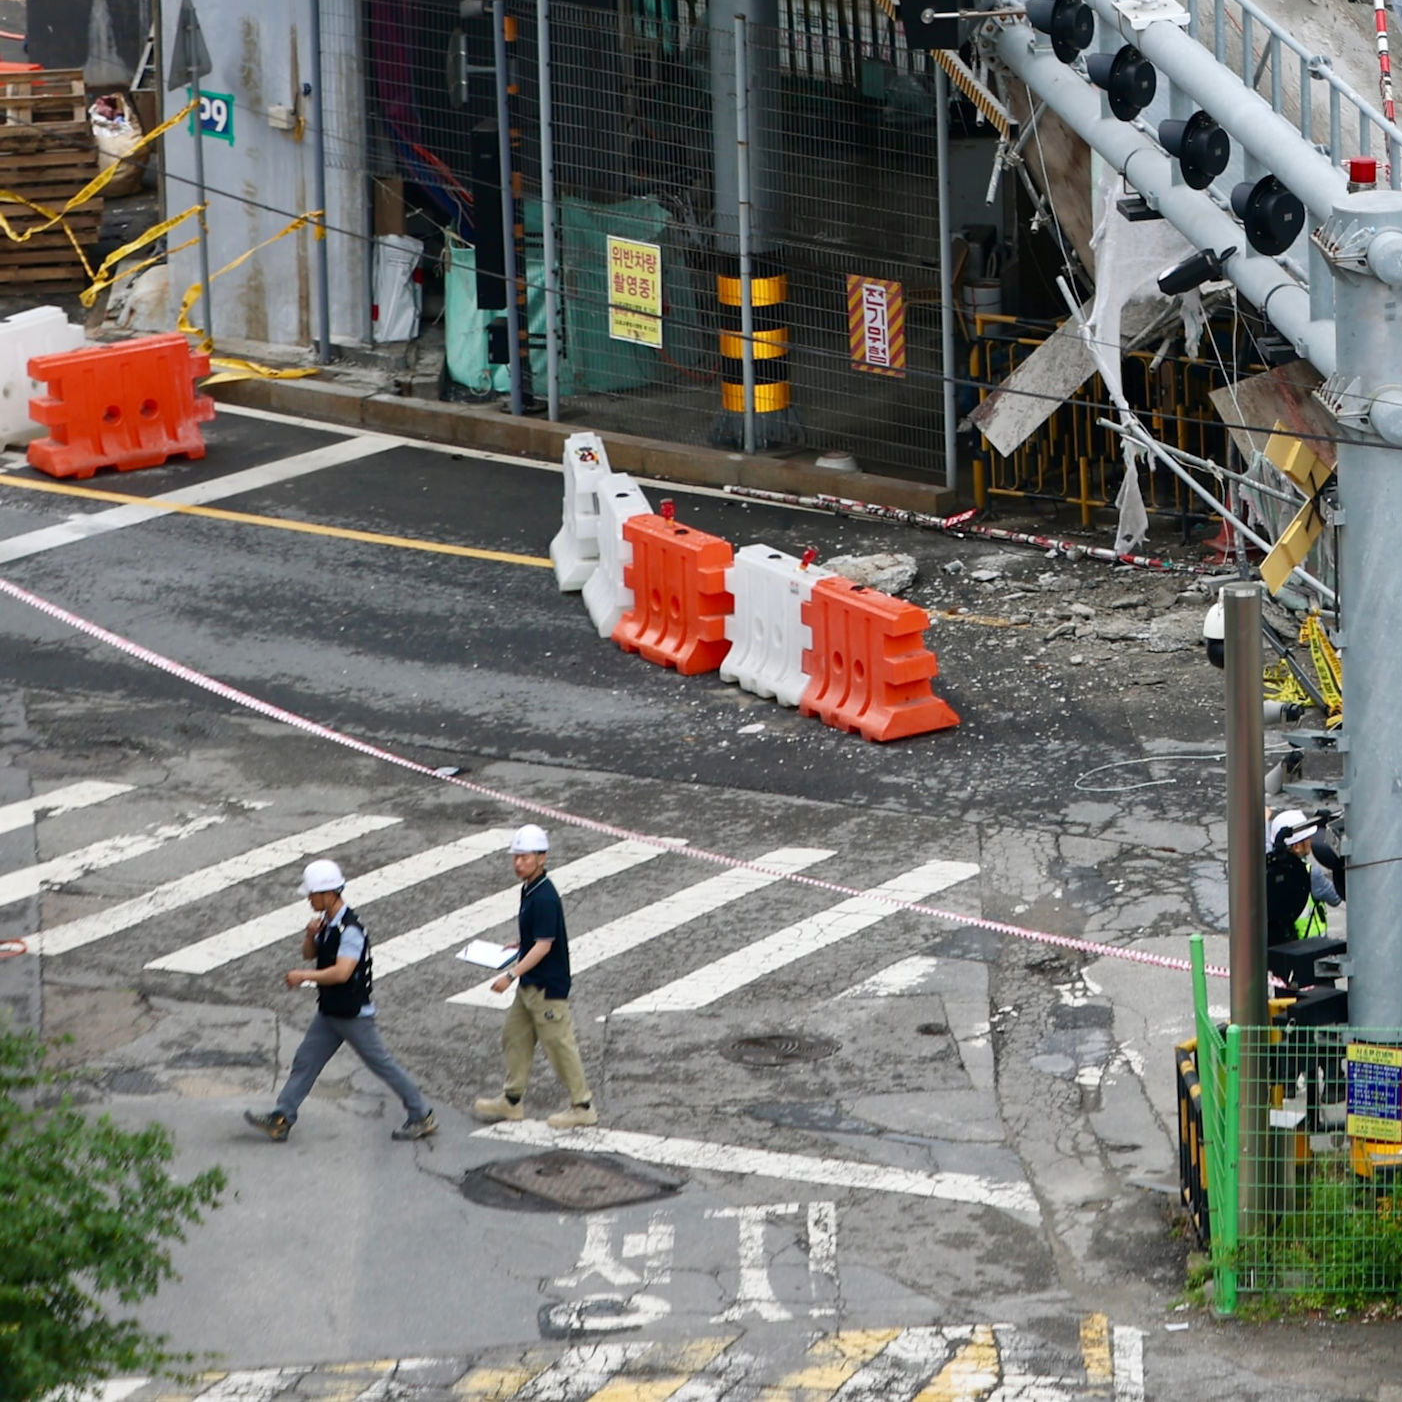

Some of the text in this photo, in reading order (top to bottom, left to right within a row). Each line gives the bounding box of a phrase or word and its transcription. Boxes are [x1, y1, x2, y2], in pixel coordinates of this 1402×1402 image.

[612, 246, 657, 275] 위반차량
[613, 272, 656, 301] 촬영중!
[866, 287, 887, 364] 전기위험
